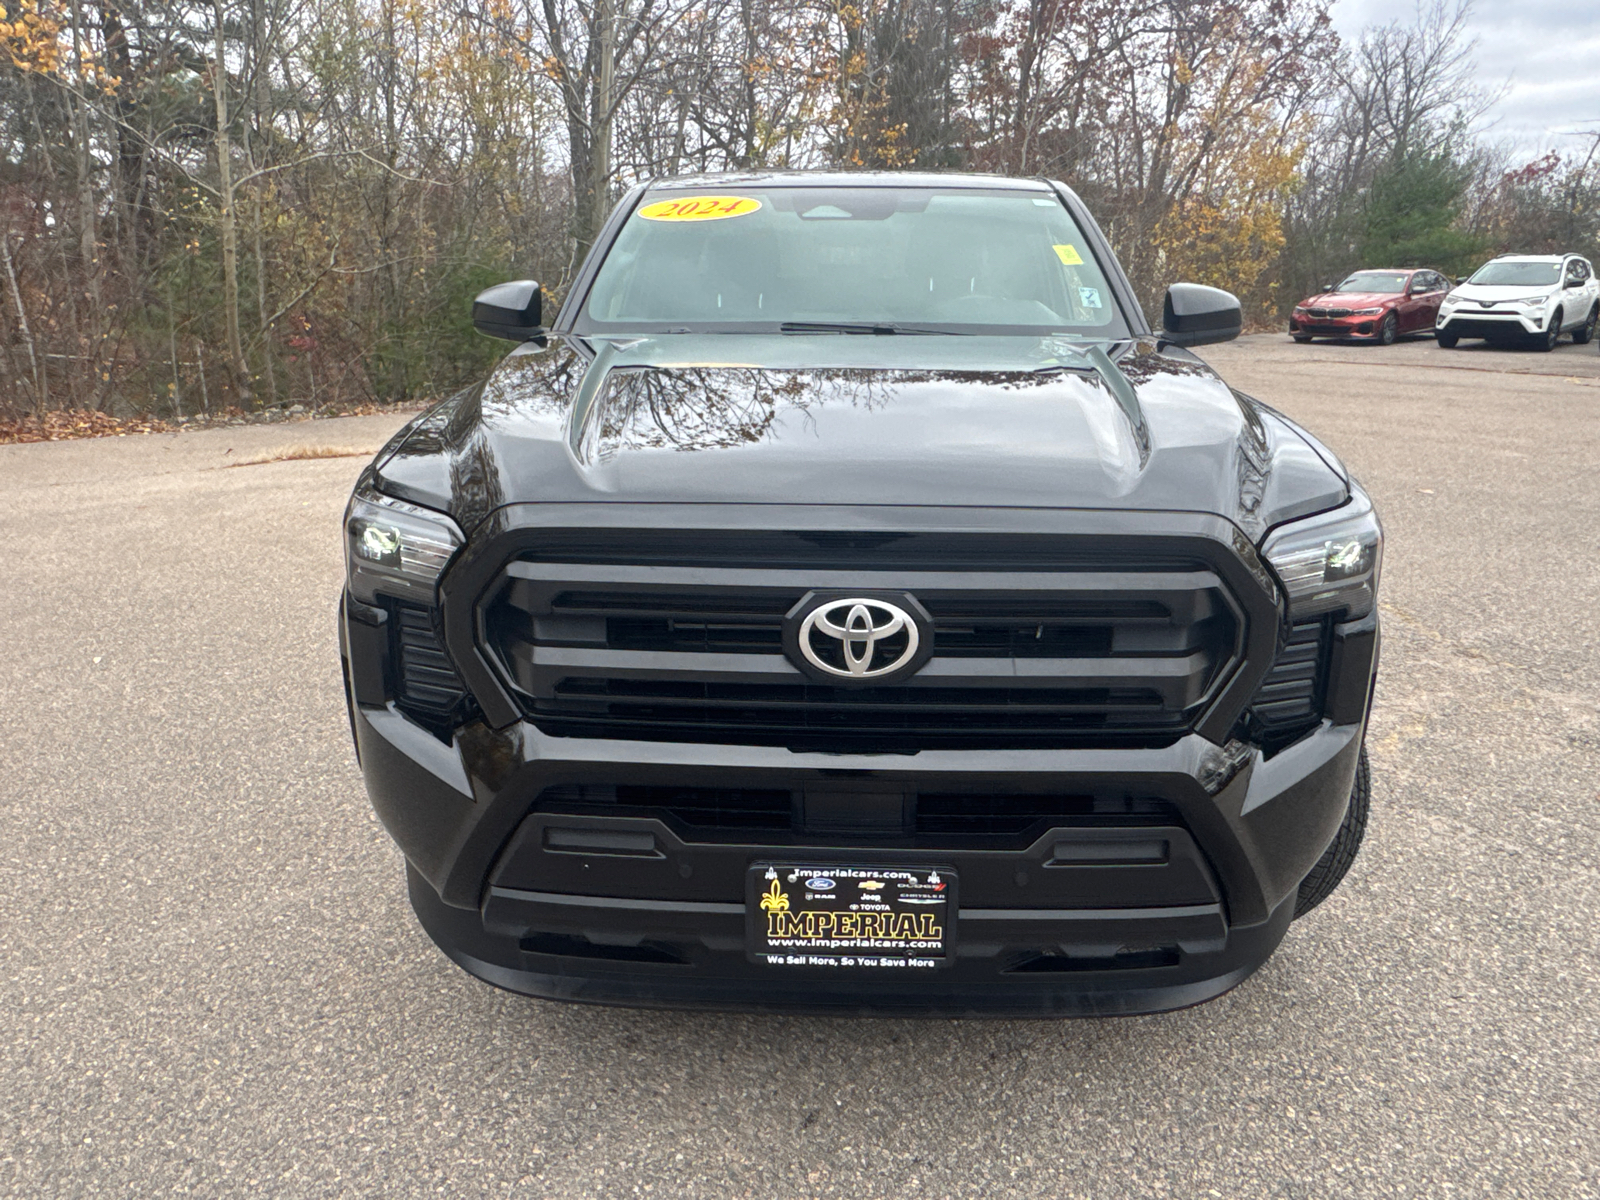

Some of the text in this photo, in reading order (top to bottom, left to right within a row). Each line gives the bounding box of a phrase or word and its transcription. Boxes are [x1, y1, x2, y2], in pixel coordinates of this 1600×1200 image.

[656, 200, 744, 217] 2024
[794, 868, 911, 879] Imperialcars.com
[860, 893, 882, 902] Jeep
[767, 911, 942, 940] IMPERIAL
[768, 938, 942, 949] www.imperialcars.com
[767, 955, 935, 968] We Sell More, So You Save More
